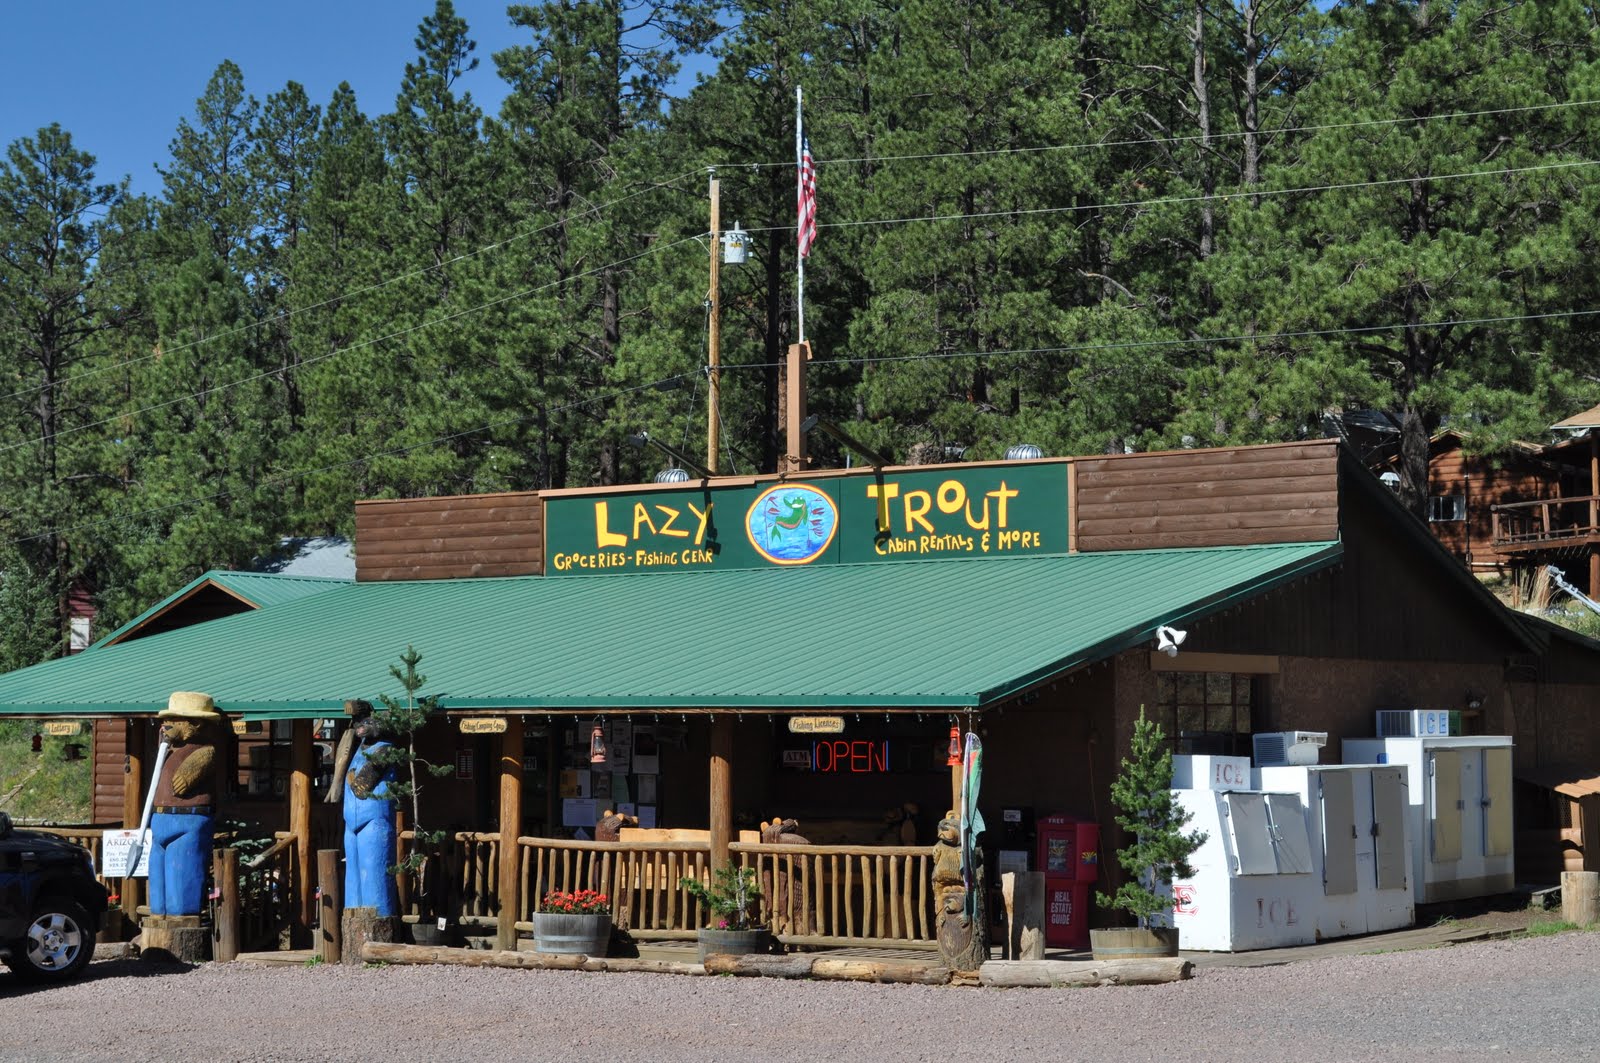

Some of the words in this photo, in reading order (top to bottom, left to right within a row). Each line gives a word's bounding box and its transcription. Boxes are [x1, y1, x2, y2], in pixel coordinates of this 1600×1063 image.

[595, 501, 714, 549] LAZY
[1419, 712, 1447, 734] ICE
[785, 751, 808, 761] ATM
[816, 741, 886, 772] OPEN
[1215, 760, 1243, 785] ICE
[106, 837, 149, 846] ARIZOA
[1054, 891, 1070, 902] REAL
[1050, 902, 1072, 914] ESTATE
[1051, 914, 1070, 925] GUIDE
